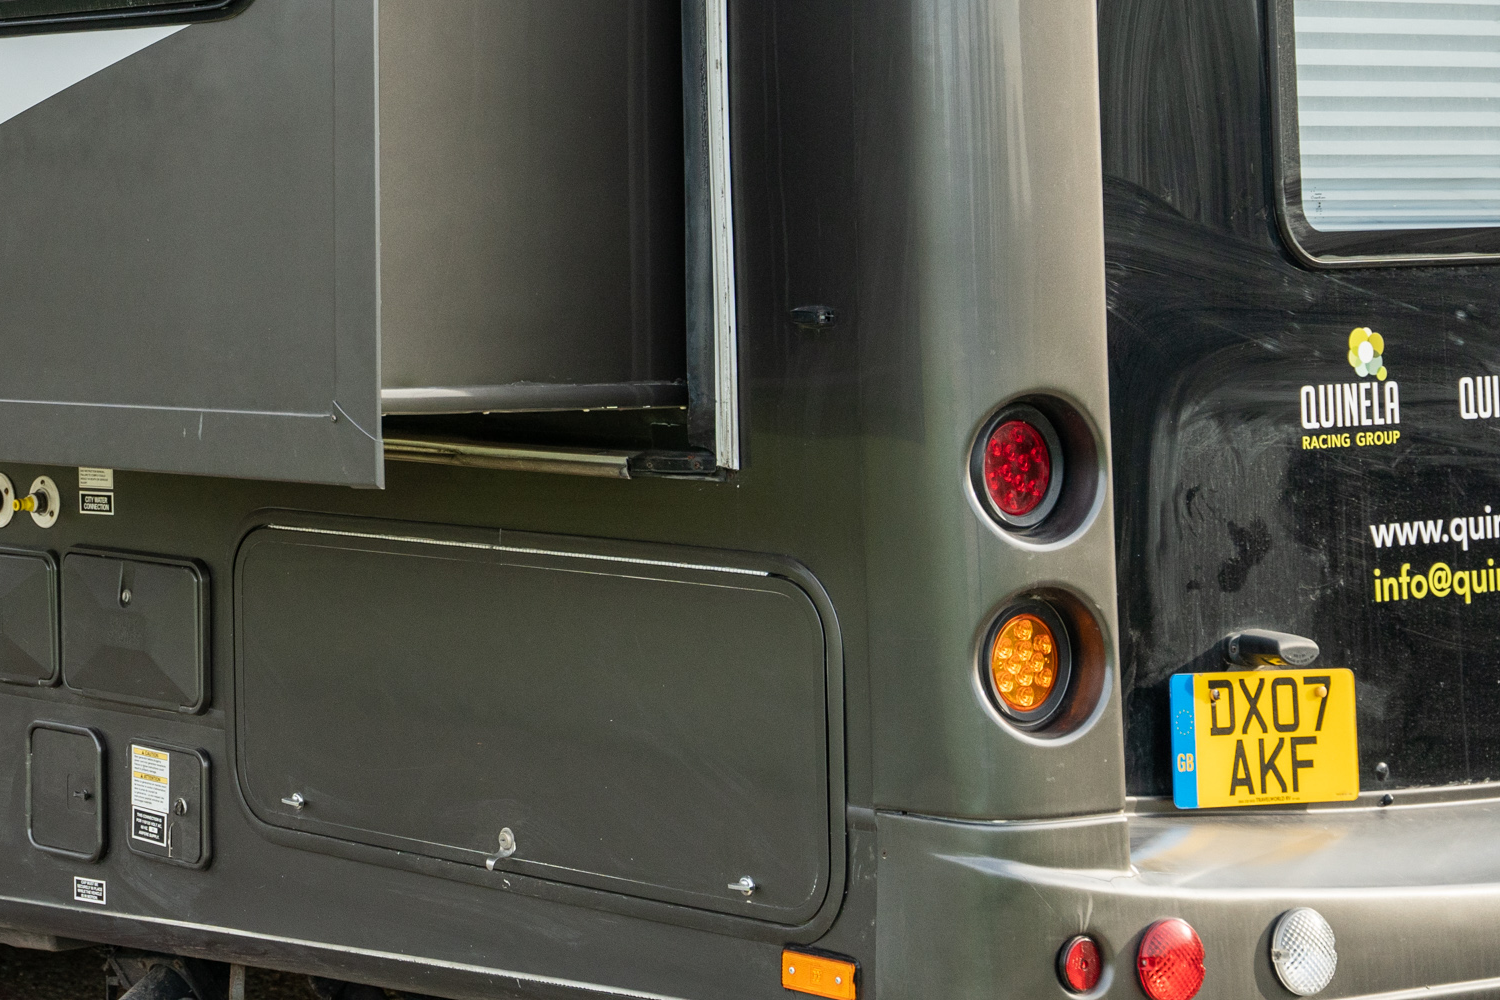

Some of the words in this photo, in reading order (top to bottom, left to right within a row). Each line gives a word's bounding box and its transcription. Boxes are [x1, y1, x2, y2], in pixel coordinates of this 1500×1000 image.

[1300, 381, 1400, 429] QUINELA
[1302, 433, 1351, 450] RACING
[1355, 430, 1400, 446] GROUP
[83, 503, 110, 511] CONNECTION
[94, 496, 108, 504] WATER
[1373, 558, 1500, 604] info@qui
[1208, 676, 1331, 736] DX07
[1177, 753, 1195, 772] GB
[1229, 736, 1317, 796] AKF
